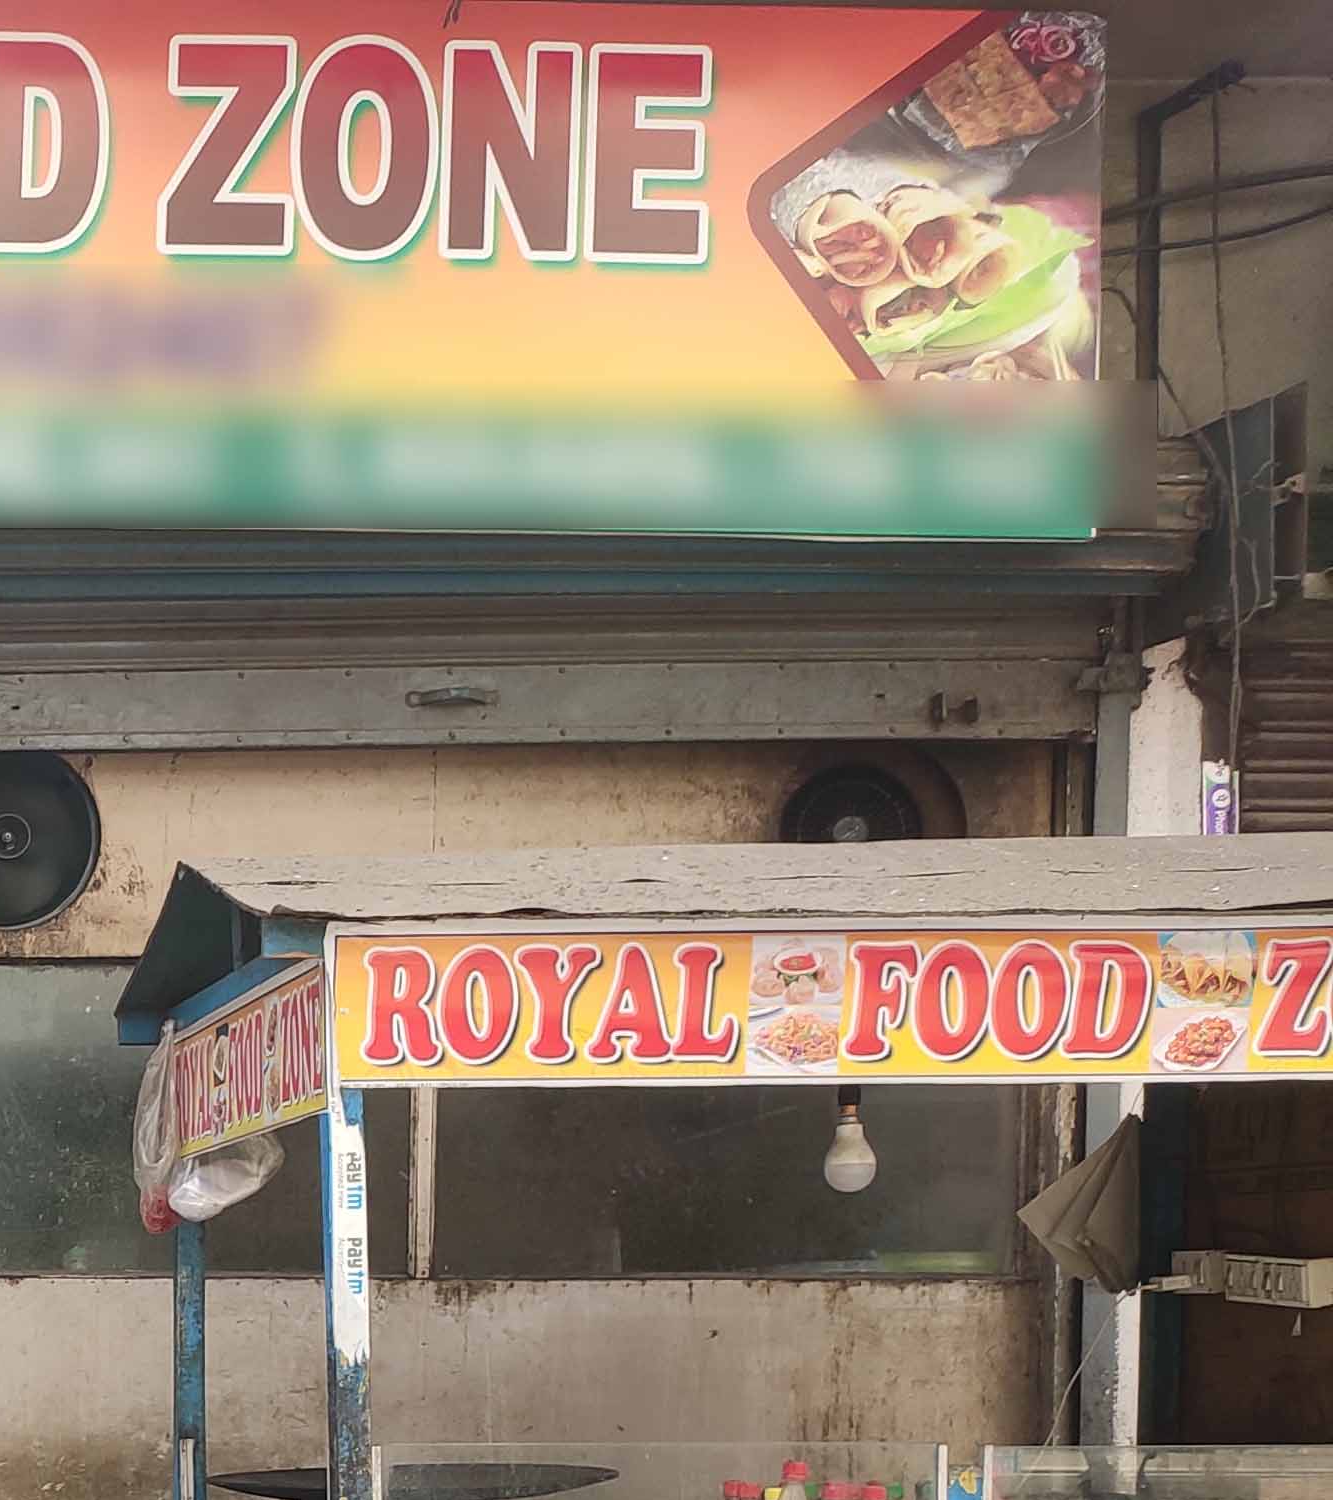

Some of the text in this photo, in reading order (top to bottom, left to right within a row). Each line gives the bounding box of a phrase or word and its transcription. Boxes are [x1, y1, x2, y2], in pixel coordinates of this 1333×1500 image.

[157, 35, 714, 264] ZONE
[226, 1009, 264, 1130] FOOD
[280, 975, 325, 1108] ZONE
[365, 945, 735, 1064] ROYAL
[845, 942, 1149, 1060] FOOD
